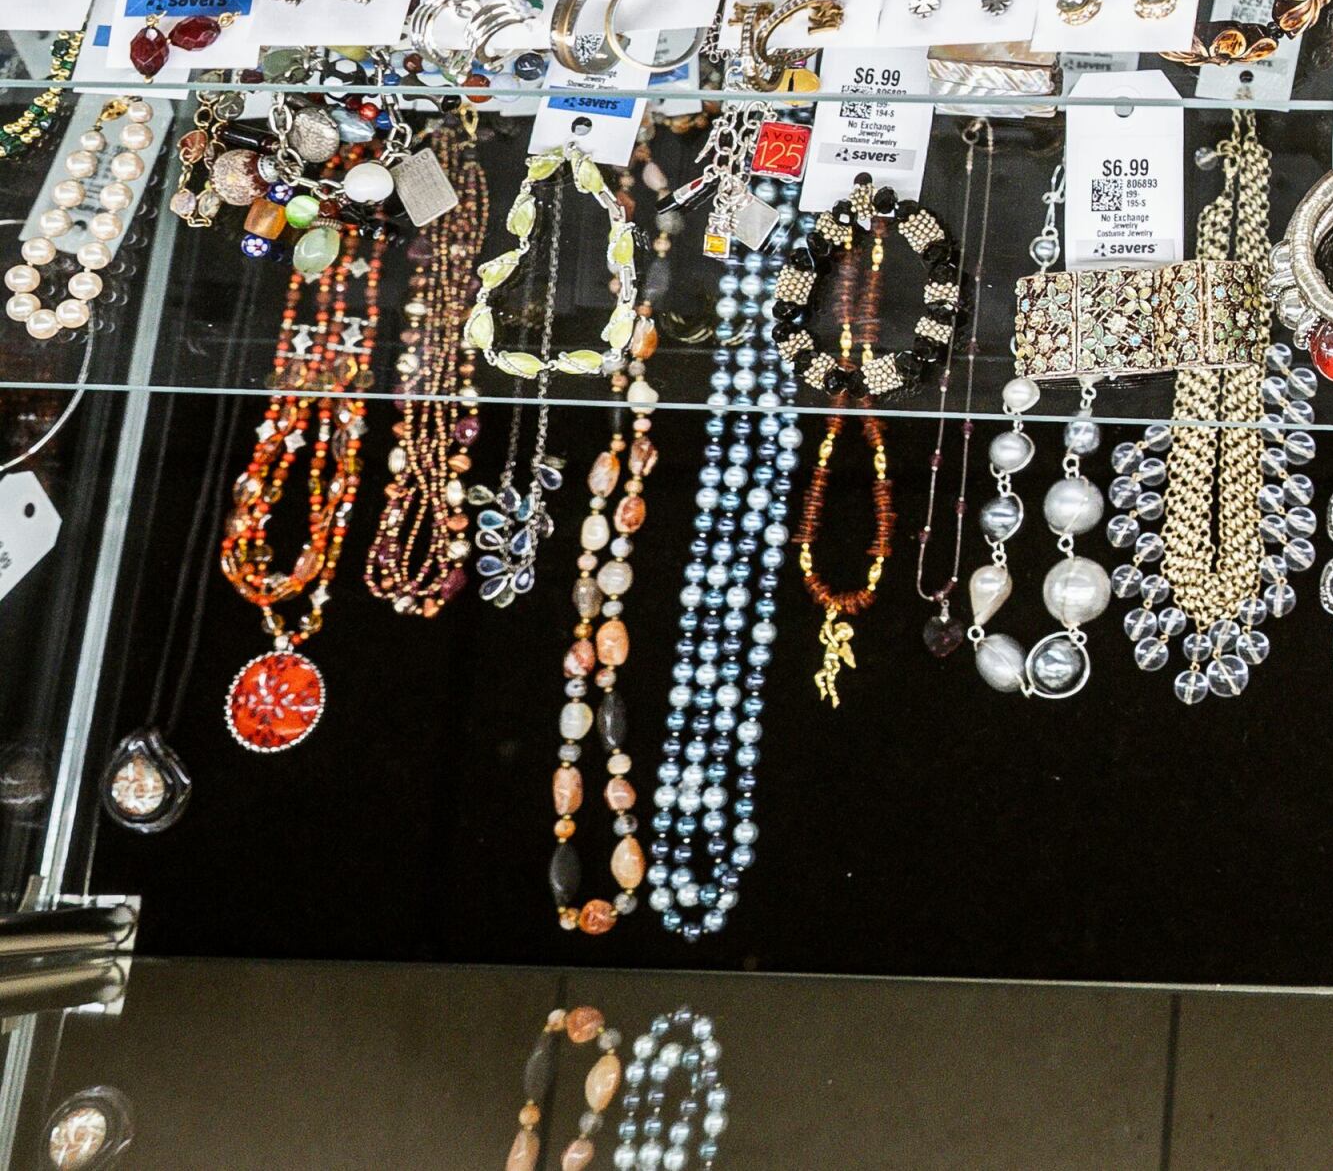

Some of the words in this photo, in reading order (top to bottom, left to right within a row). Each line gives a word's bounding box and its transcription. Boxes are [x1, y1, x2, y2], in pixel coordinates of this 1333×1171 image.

[853, 66, 900, 86] $6.99
[760, 141, 802, 169] 125
[851, 150, 899, 162] savers
[1102, 158, 1148, 177] $6.99
[1126, 178, 1157, 188] 806893
[1109, 243, 1155, 254] savers
